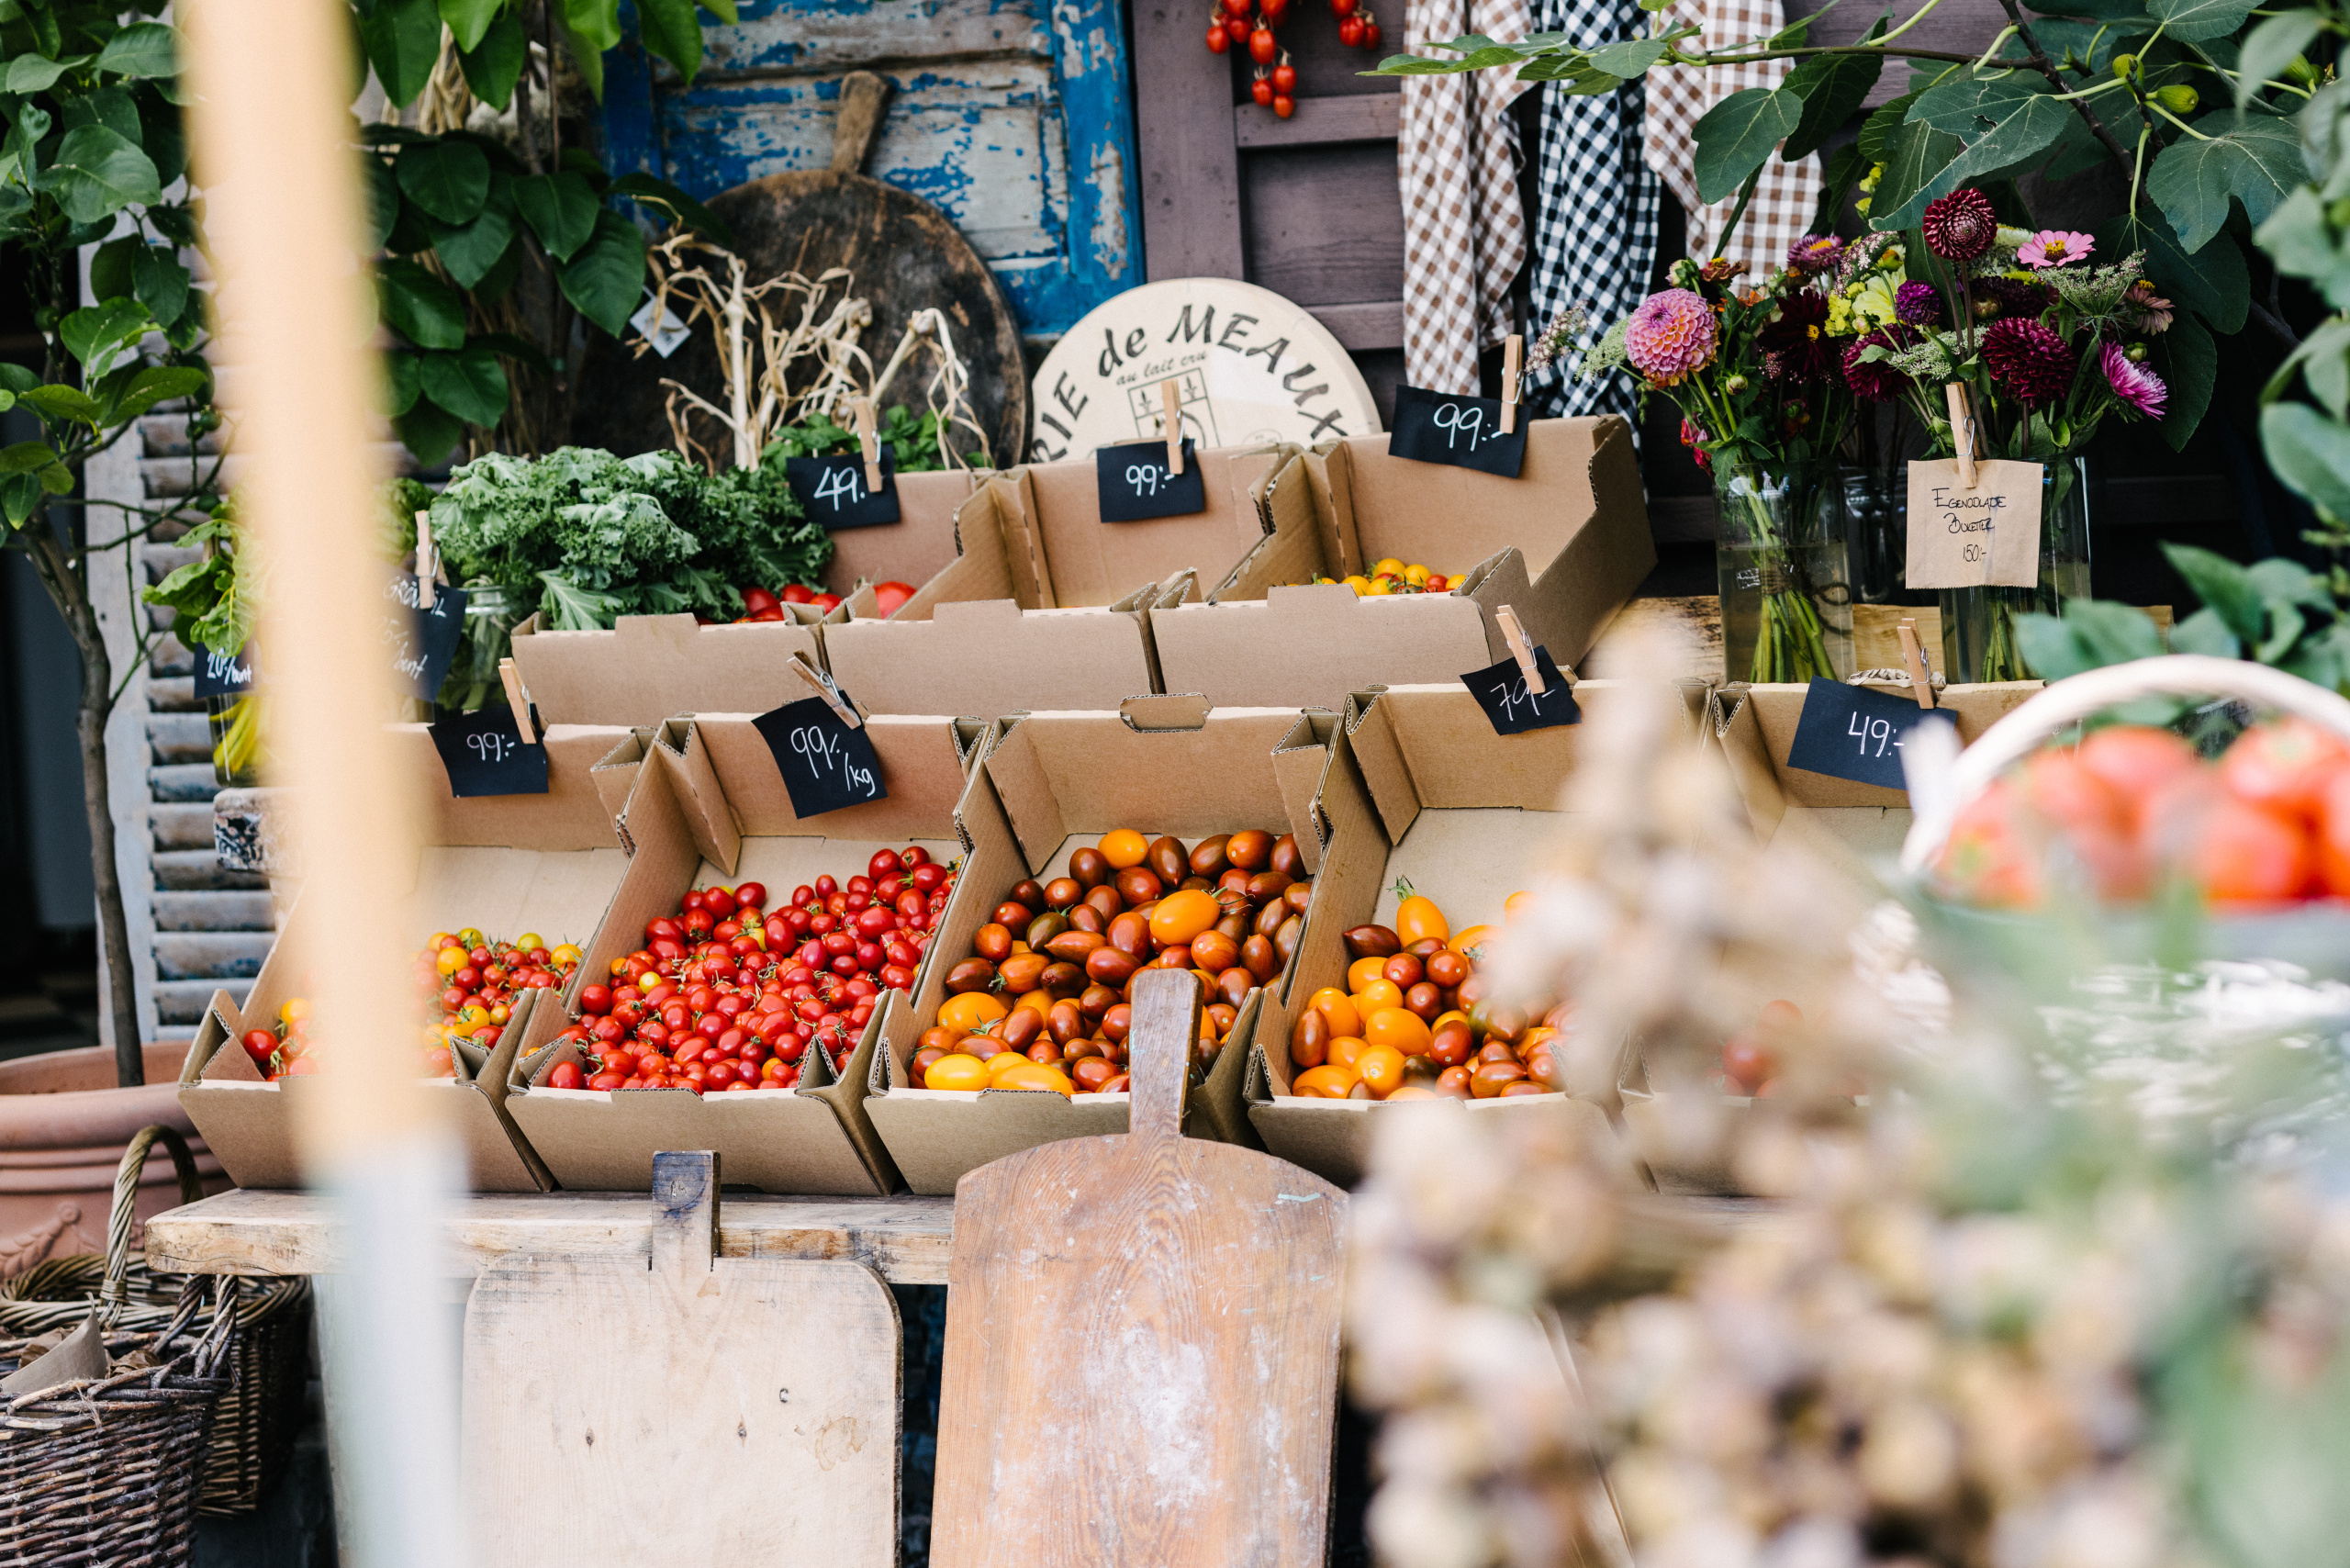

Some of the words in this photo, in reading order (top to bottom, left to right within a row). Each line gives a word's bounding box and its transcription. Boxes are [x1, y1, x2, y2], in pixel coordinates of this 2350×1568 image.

[1030, 369, 1089, 463] RIE
[1098, 327, 1147, 377] de
[1166, 304, 1349, 441] MEAUX
[1116, 371, 1137, 386] au
[1143, 358, 1175, 377] lait
[1180, 350, 1208, 366] cru
[1125, 464, 1175, 497] 99:-
[1963, 543, 1987, 563] 150:-
[466, 732, 515, 762] 99:-
[1848, 711, 1906, 757] 49:-
[845, 752, 876, 798] /kg
